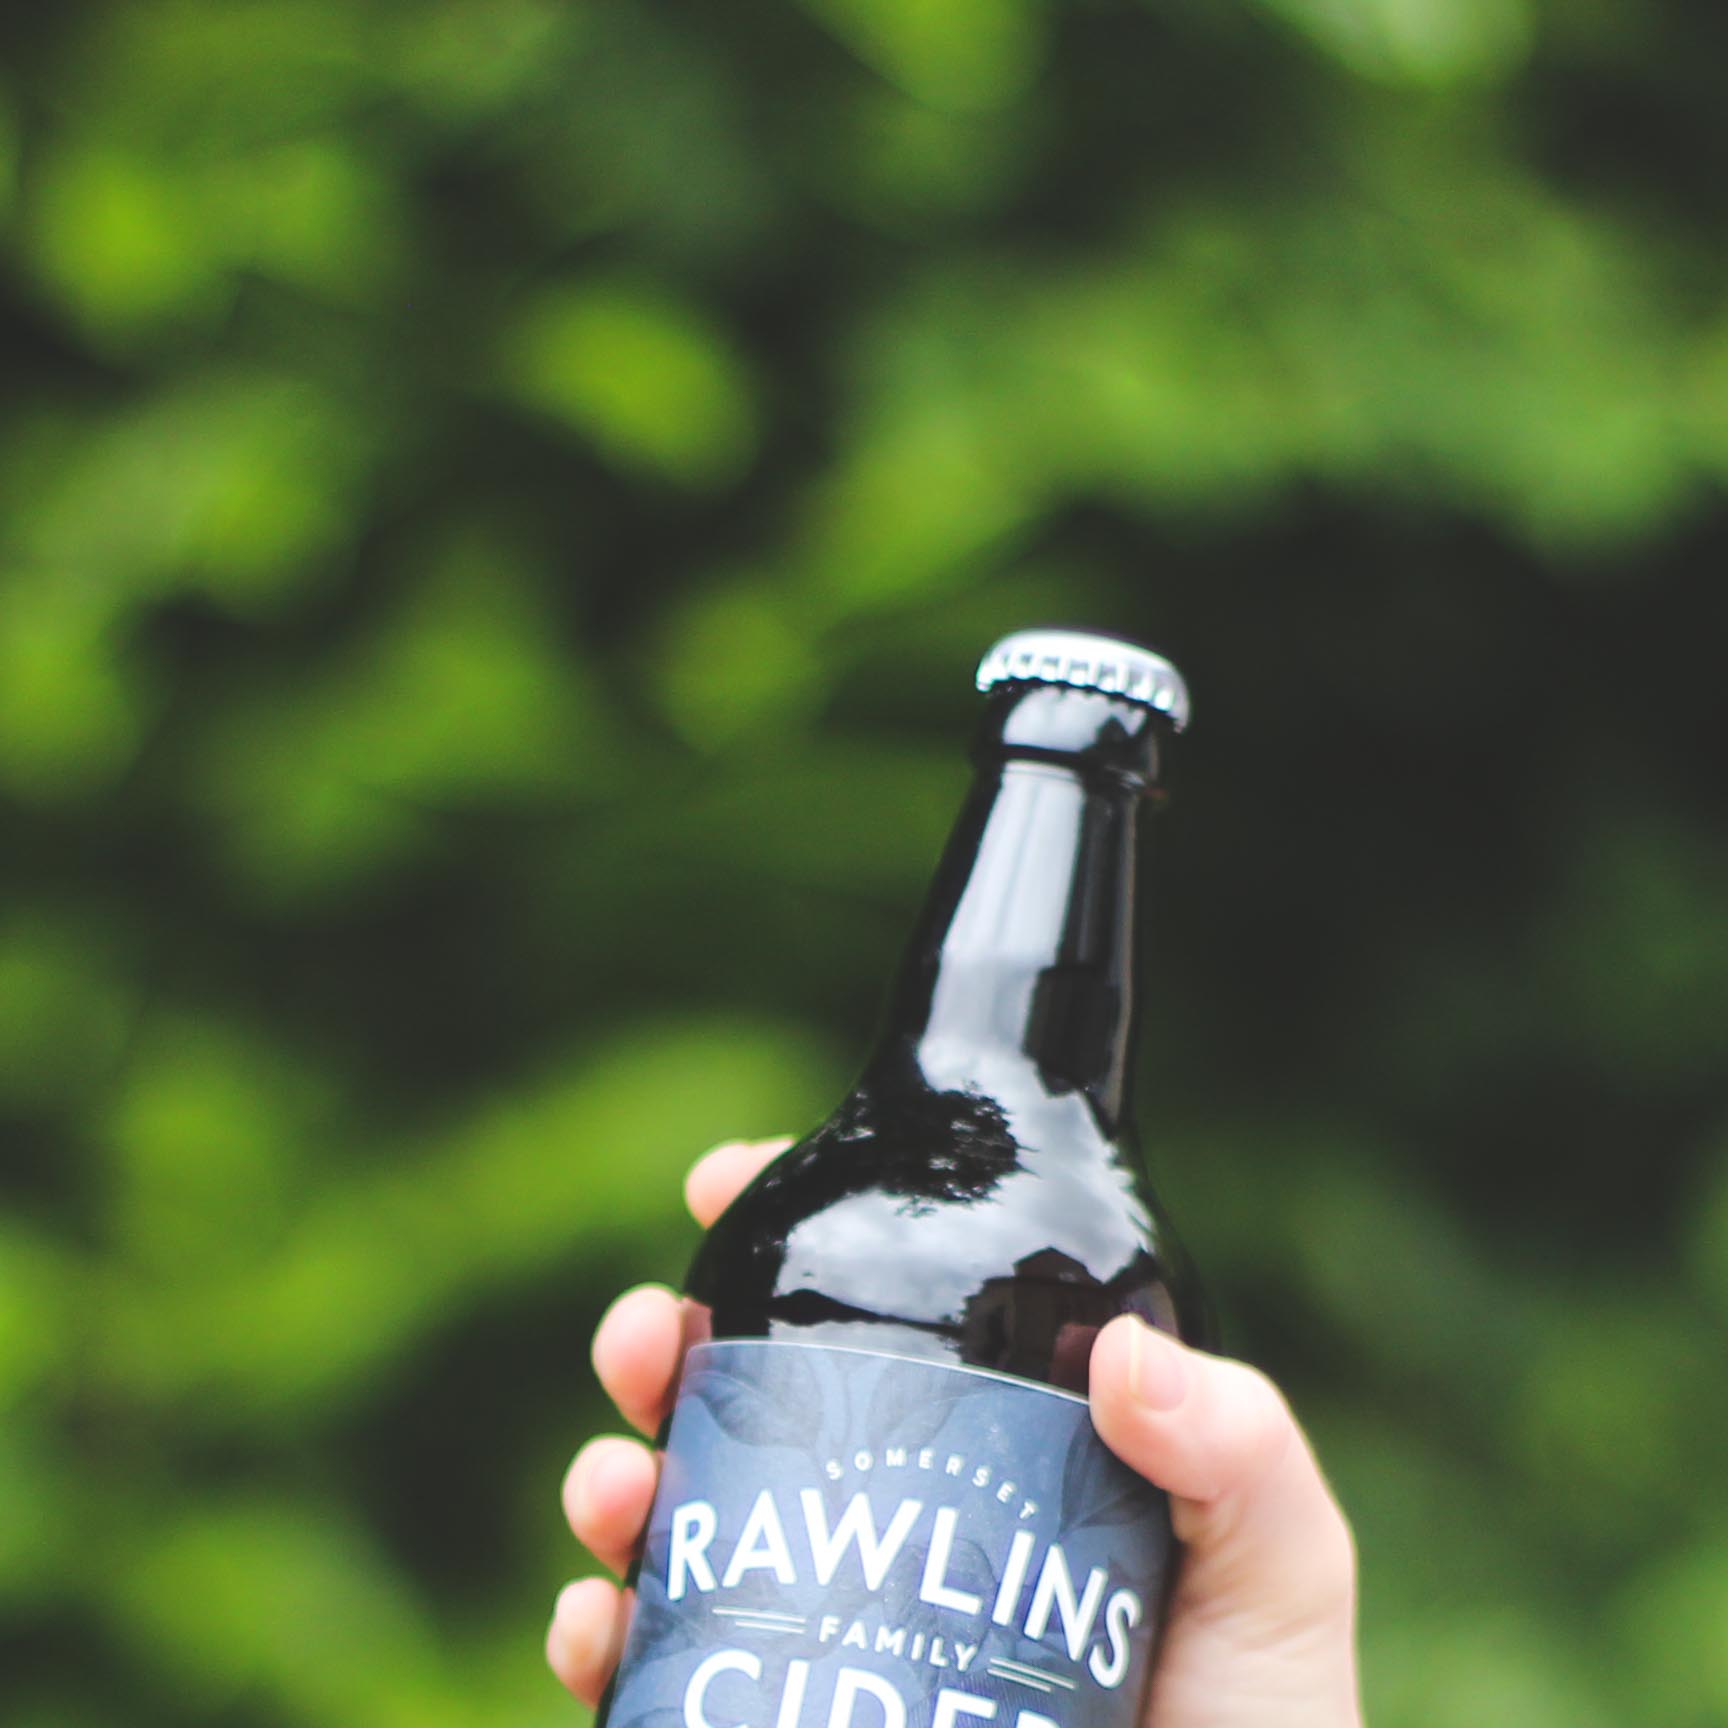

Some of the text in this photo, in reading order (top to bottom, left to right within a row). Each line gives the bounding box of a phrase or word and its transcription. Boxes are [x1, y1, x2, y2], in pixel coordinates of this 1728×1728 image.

[826, 1448, 1038, 1520] SOMERSET
[667, 1488, 1142, 1689] RAWLINS
[818, 1616, 978, 1672] FAMILY
